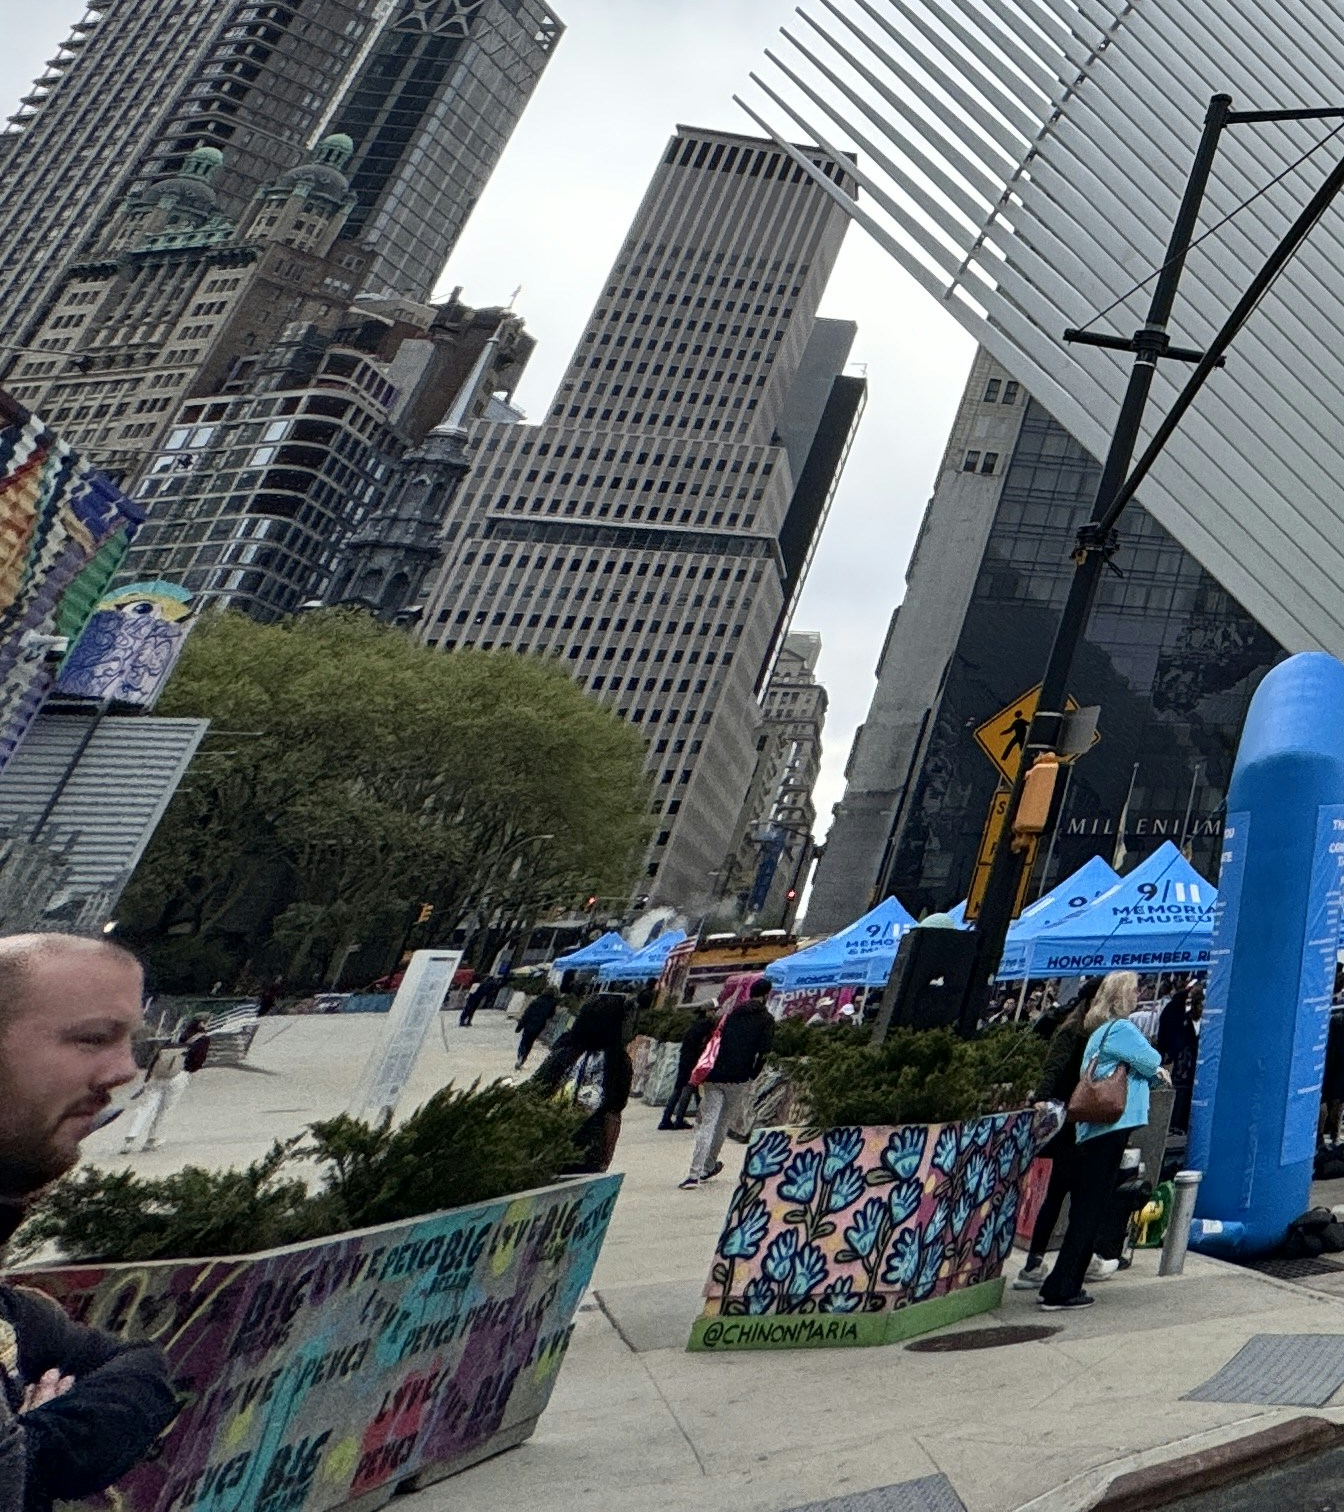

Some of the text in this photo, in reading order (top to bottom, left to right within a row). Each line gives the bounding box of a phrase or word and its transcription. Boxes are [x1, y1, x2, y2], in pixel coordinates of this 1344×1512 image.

[1137, 879, 1201, 904] 9/11
[1112, 904, 1216, 917] MEMORIA
[1133, 914, 1212, 925] MUSEU
[703, 1320, 857, 1347] @CHINONMARIA
